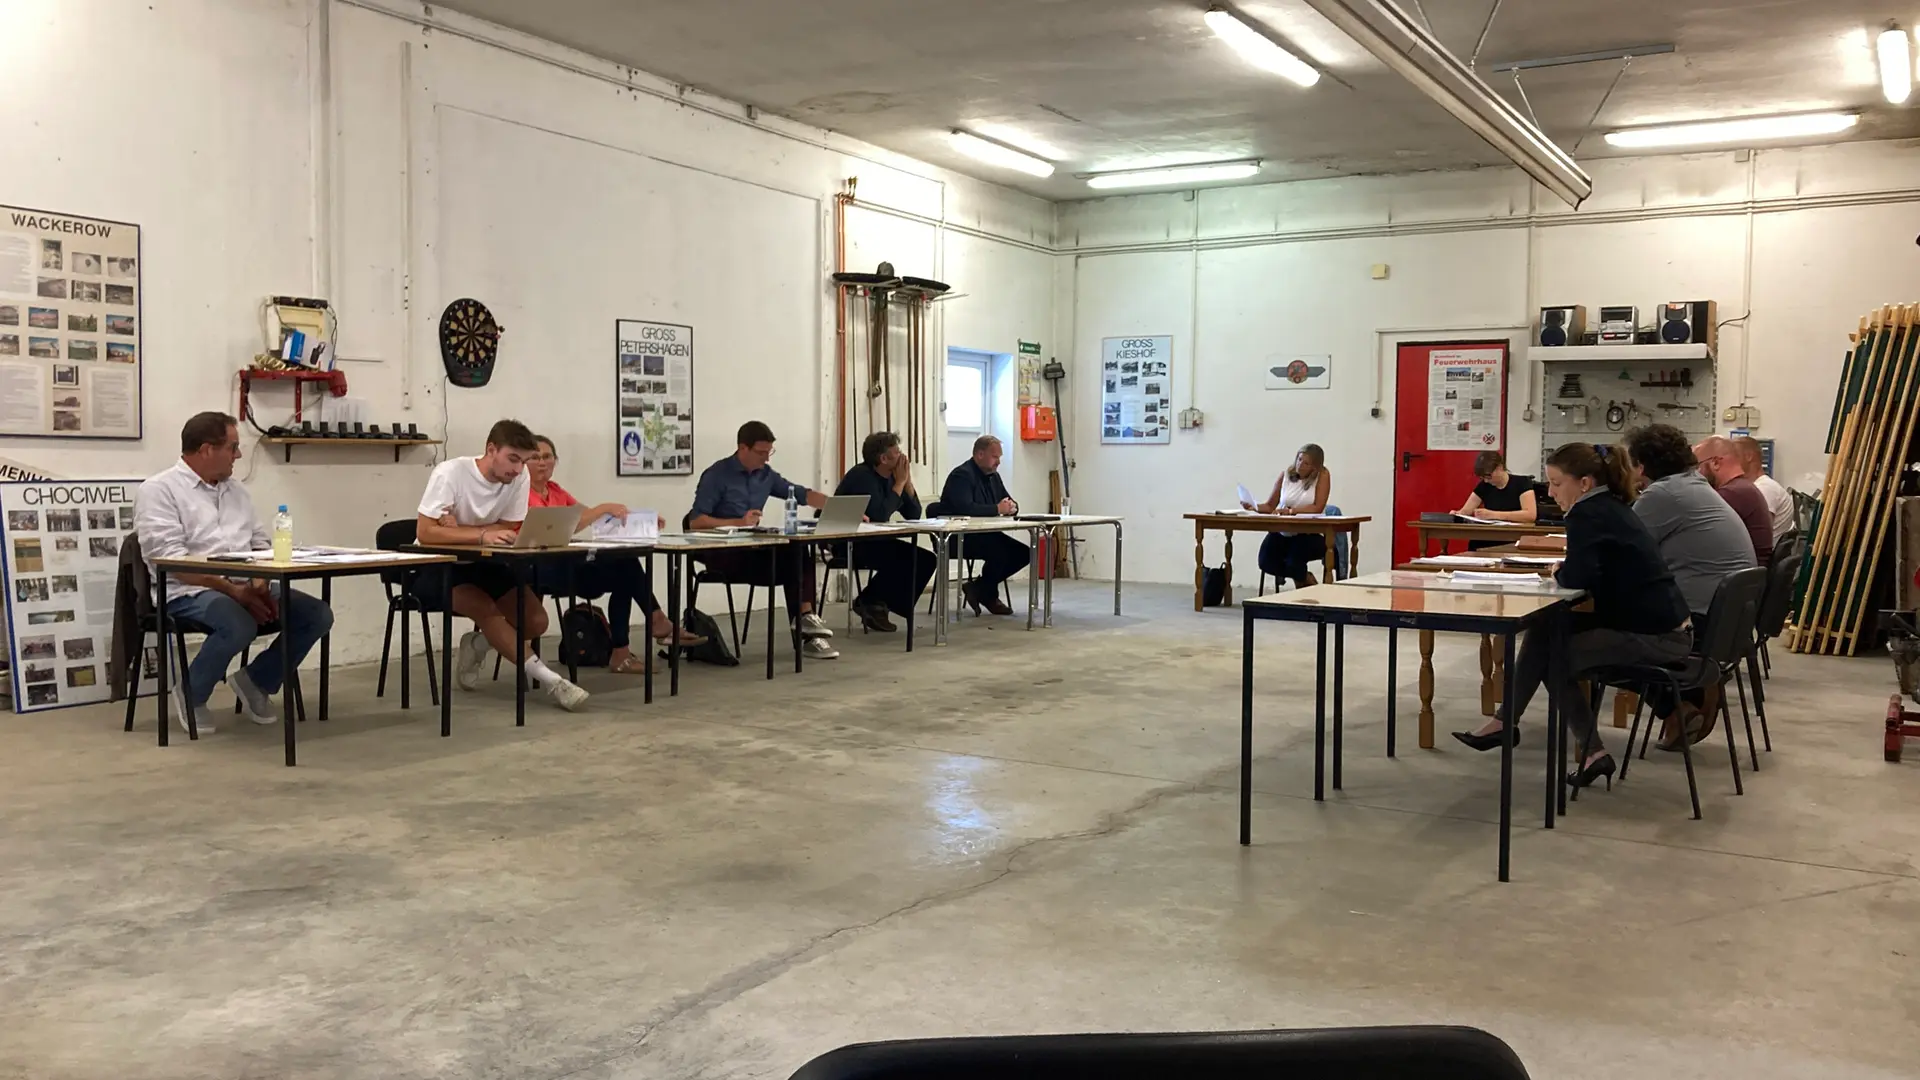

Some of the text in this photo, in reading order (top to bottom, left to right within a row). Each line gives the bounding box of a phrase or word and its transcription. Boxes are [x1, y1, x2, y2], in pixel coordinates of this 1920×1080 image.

[11, 213, 111, 238] WACKEROW
[641, 326, 676, 341] GROSS
[620, 340, 689, 357] PETERSHAGEN
[1121, 338, 1153, 349] GROSS
[1116, 348, 1157, 359] KIESHOF
[1434, 358, 1497, 366] Feuerwehrhaus
[23, 485, 133, 505] CHOCIWEL
